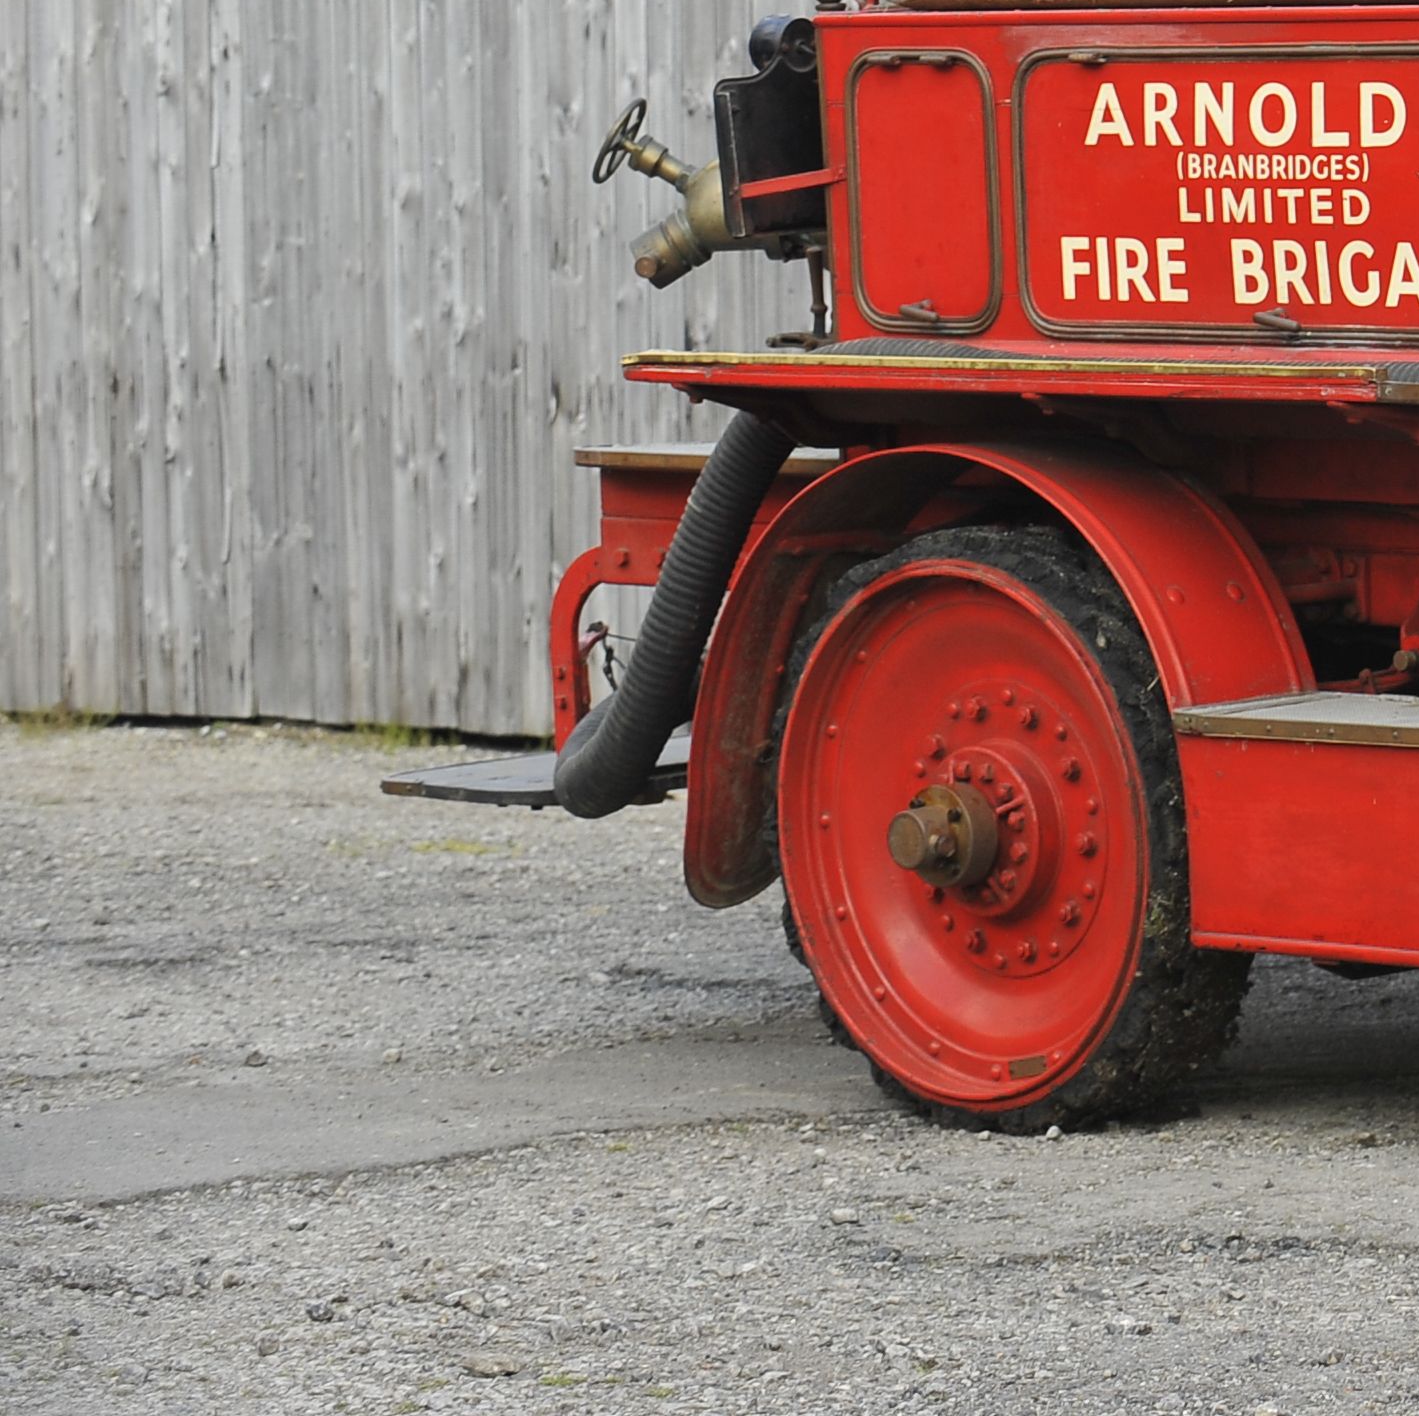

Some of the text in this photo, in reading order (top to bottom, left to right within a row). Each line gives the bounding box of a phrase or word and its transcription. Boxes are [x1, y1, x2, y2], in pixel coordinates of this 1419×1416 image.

[1176, 152, 1370, 181] (BRANBRIDGES)
[1179, 187, 1370, 225] LIMITED
[1061, 236, 1189, 302] FIRE
